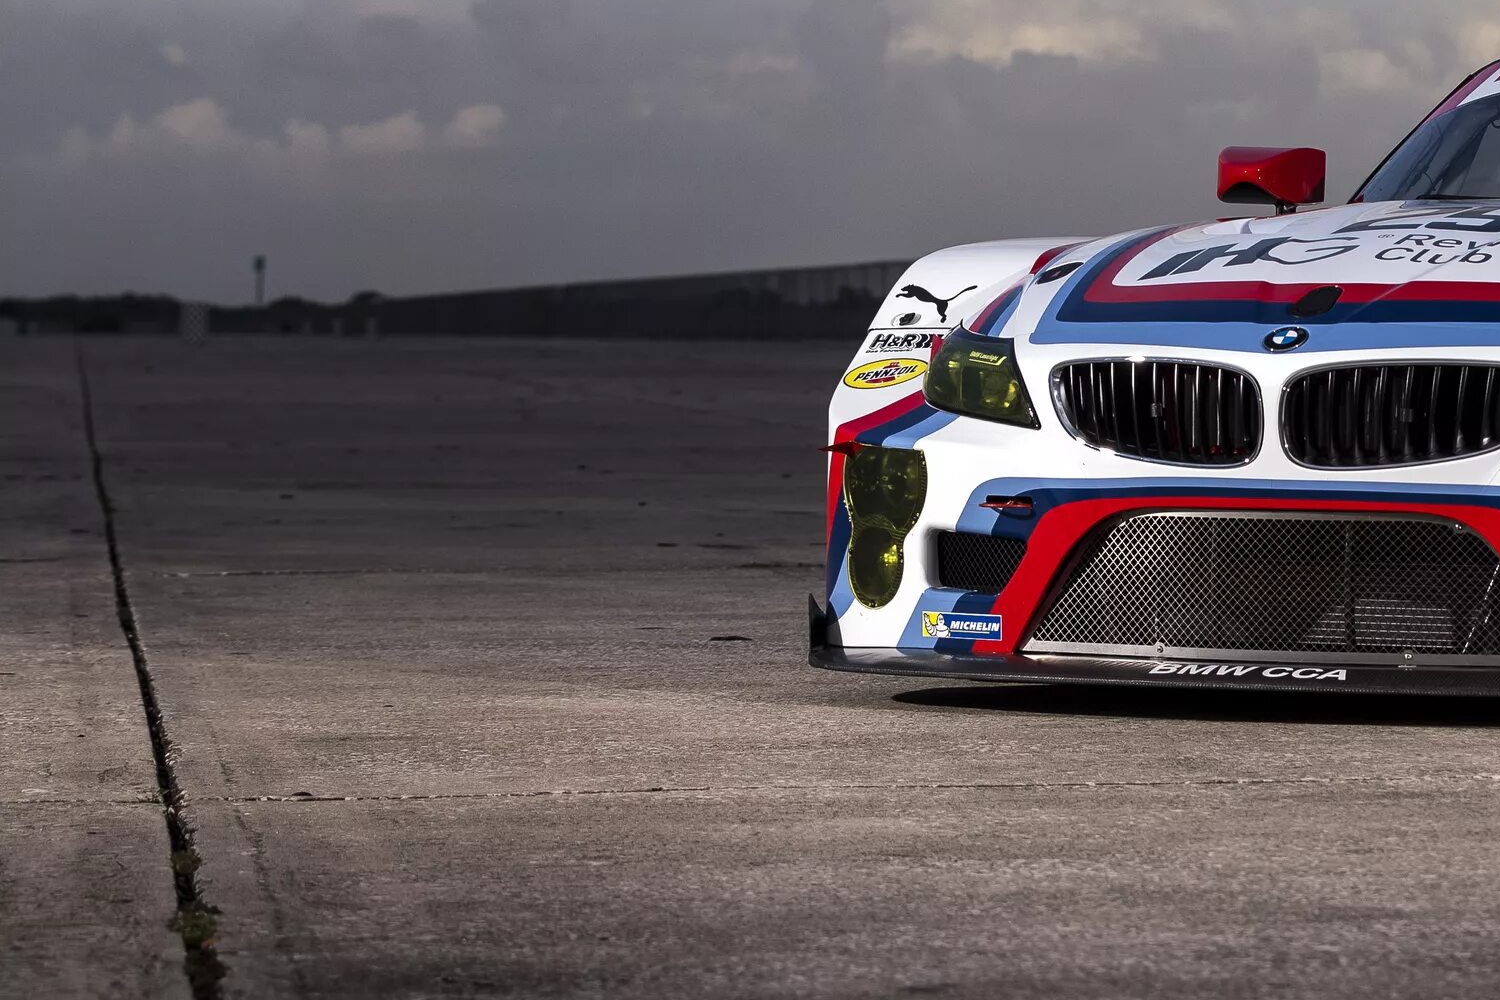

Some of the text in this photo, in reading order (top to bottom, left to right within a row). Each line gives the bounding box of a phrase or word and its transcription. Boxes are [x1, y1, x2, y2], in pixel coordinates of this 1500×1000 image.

[1137, 236, 1360, 281] IHG
[1374, 247, 1493, 265] Club
[869, 333, 915, 350] H&R
[854, 364, 918, 382] PENNZOIL
[950, 620, 1000, 632] MICHELIN
[1149, 663, 1348, 681] BMW CCA
